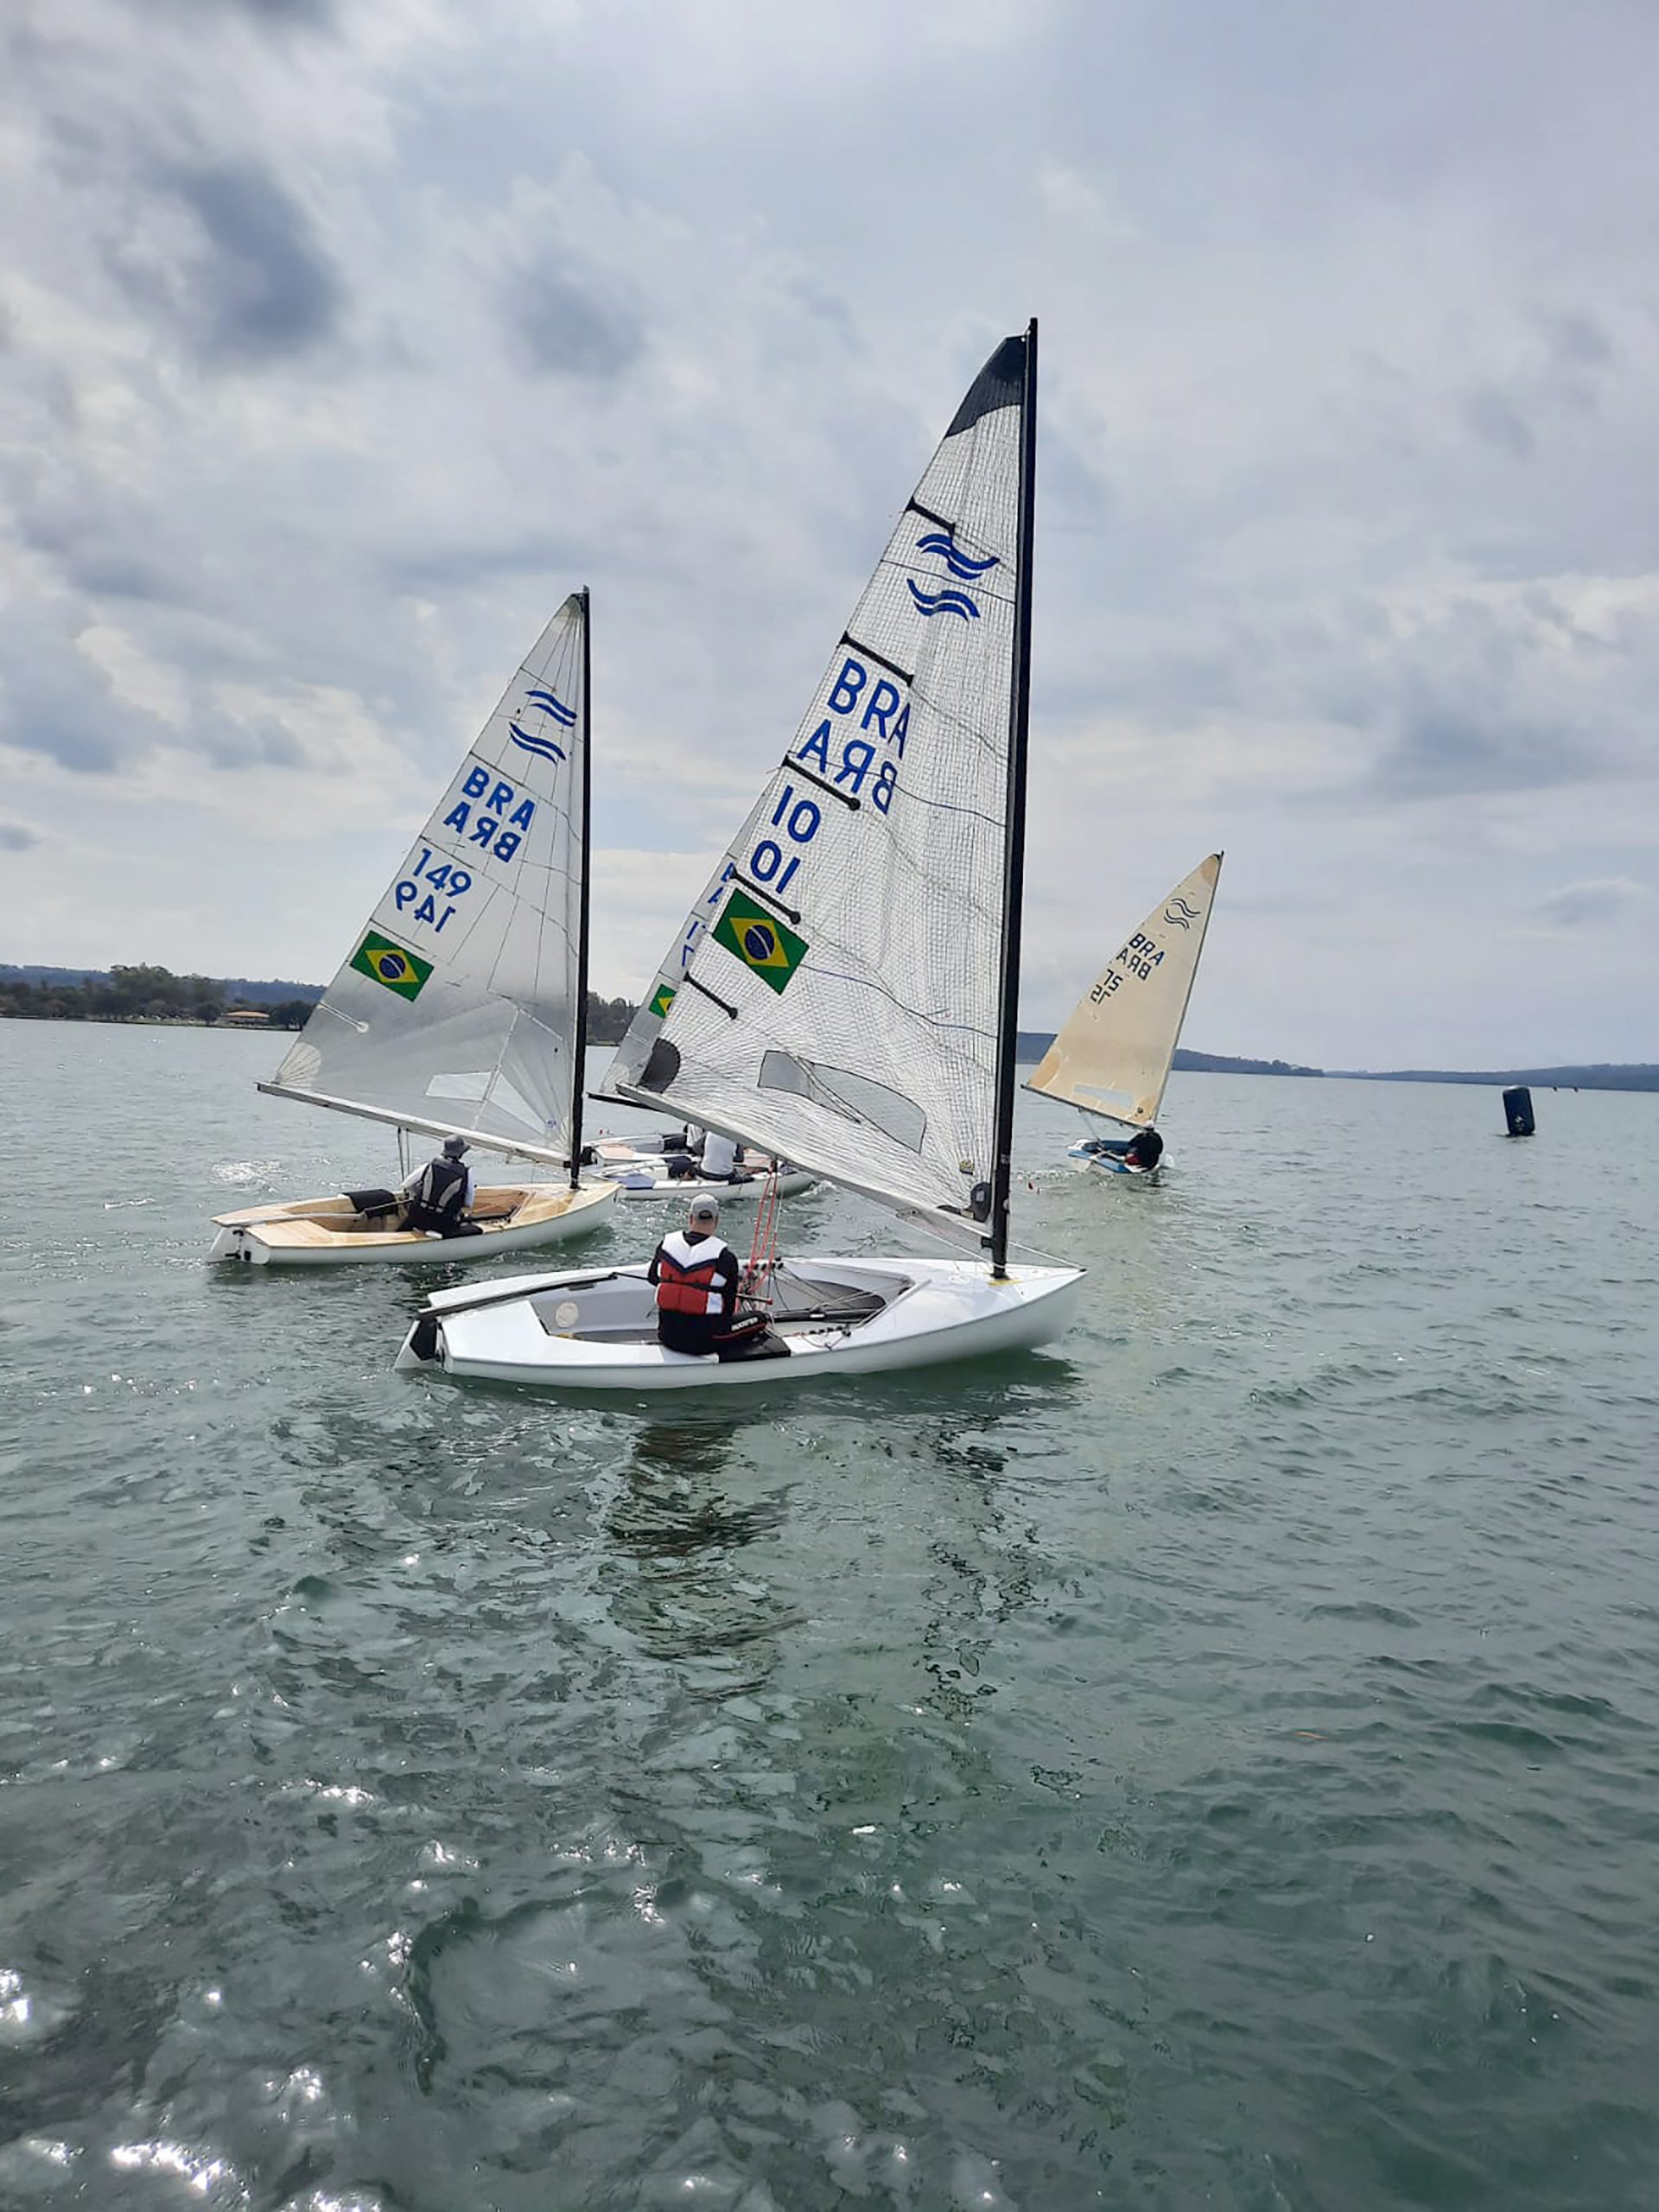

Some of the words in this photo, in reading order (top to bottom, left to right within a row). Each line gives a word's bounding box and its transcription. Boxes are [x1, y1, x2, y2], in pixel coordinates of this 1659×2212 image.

[828, 658, 911, 760] BRA
[462, 766, 535, 832] BRA
[772, 785, 821, 842] 10
[413, 848, 472, 898] 149
[1128, 933, 1165, 966] BRA
[1103, 969, 1123, 991] 75
